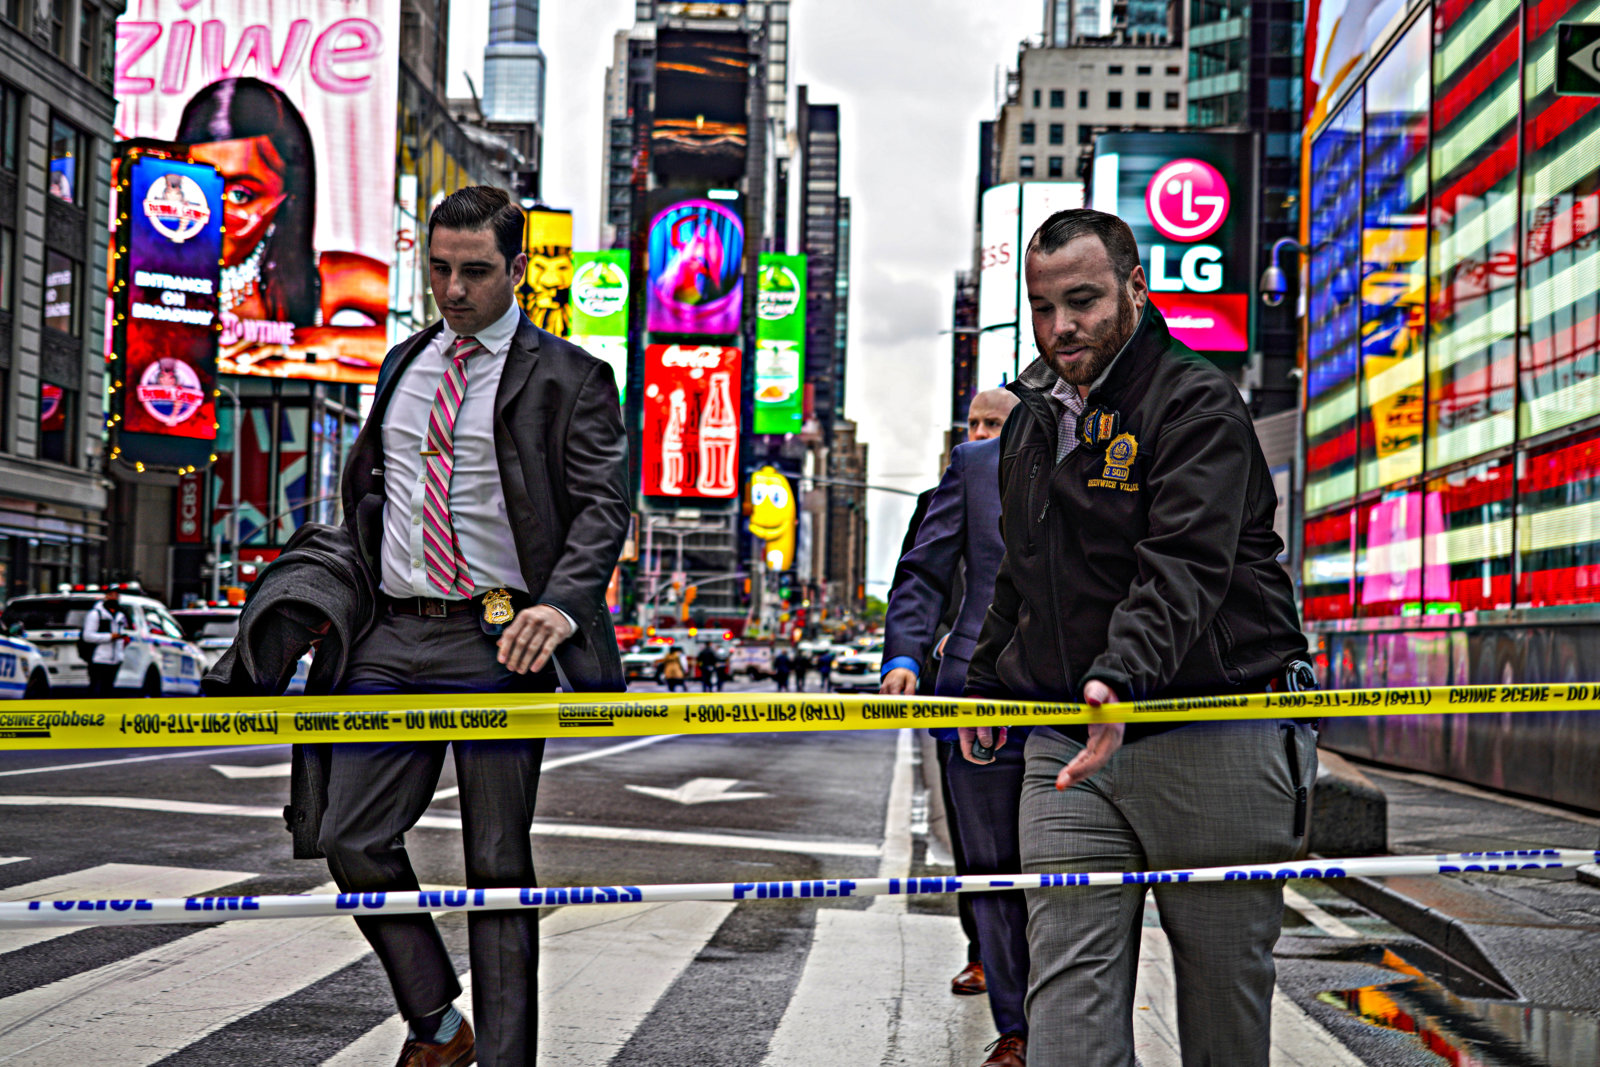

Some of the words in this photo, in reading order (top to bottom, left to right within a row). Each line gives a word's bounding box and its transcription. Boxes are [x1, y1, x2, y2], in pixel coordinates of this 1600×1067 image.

[116, 1, 384, 95] ziwe
[1150, 245, 1223, 293] LG
[135, 270, 213, 294] ENTRANCE
[160, 290, 186, 307] ON
[132, 302, 214, 326] BROADWAY
[1112, 468, 1127, 477] SQD
[182, 482, 197, 519] CBS
